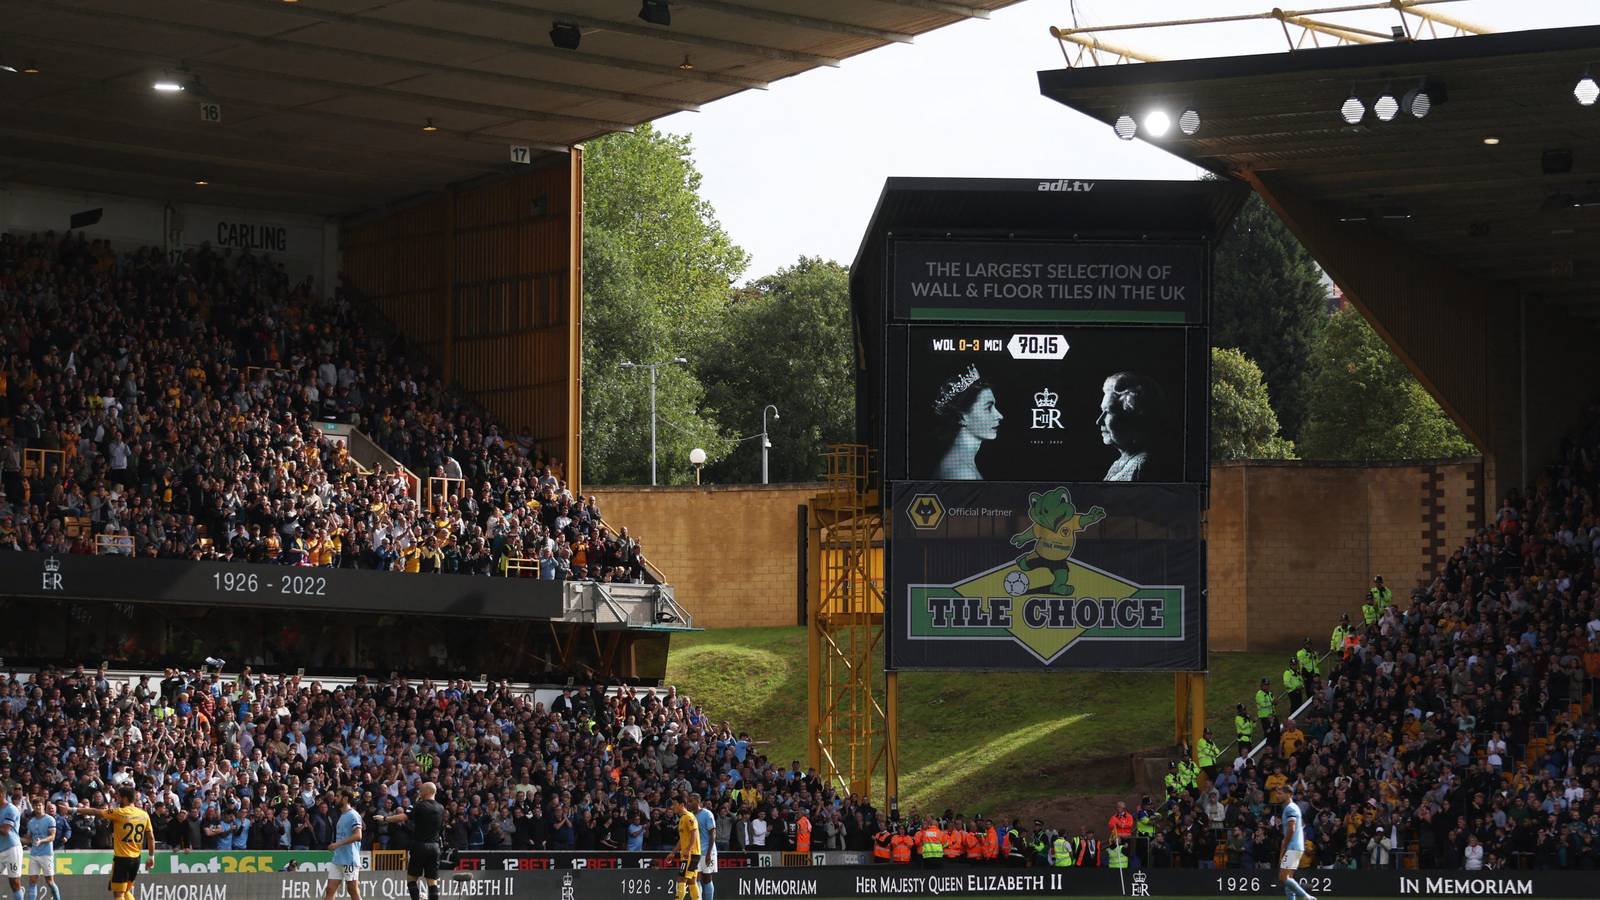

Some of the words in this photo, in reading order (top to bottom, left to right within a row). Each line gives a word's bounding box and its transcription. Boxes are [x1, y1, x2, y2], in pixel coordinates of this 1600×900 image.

[203, 105, 218, 120] 16
[513, 148, 527, 161] 17
[1037, 180, 1095, 192] adi.tv
[217, 221, 287, 251] CARLING
[926, 261, 961, 277] THE
[966, 262, 1044, 279] LARGEST
[1047, 263, 1142, 280] SELECTION
[1147, 265, 1172, 280] OF
[911, 282, 962, 298] WALL
[966, 283, 979, 298] &
[983, 283, 1043, 299] FLOOR
[1047, 284, 1093, 300] TILES
[1098, 285, 1116, 300] IN
[1121, 285, 1156, 300] THE
[1160, 286, 1186, 301] UK
[932, 339, 956, 351] WOL
[958, 339, 980, 351] 0-3
[984, 339, 1002, 351] MCI
[1018, 336, 1058, 354] 70:15
[948, 507, 979, 517] Official
[981, 507, 1013, 517] Partner
[213, 572, 258, 592] 1926
[280, 575, 326, 596] 2022
[927, 597, 1013, 628] TILE
[1022, 597, 1164, 629] CHOICE
[122, 823, 144, 843] 28
[10, 863, 18, 871] 16
[343, 864, 354, 873] 20
[760, 856, 771, 867] 16
[814, 855, 825, 867] 17
[140, 883, 227, 900] MEMORIAM
[281, 879, 311, 899] HER
[505, 877, 514, 896] II
[620, 879, 651, 894] 1926
[739, 878, 751, 896] IN
[754, 877, 817, 896] MEMORIAM
[856, 876, 877, 893] HER
[880, 876, 926, 893] MAJESTY
[928, 875, 963, 895] QUEEN
[967, 874, 1044, 891] ELIZABETH
[1051, 873, 1063, 890] II
[1217, 877, 1260, 891] 1926
[1400, 876, 1419, 893] IN
[1425, 877, 1533, 894] MEMORIAM
